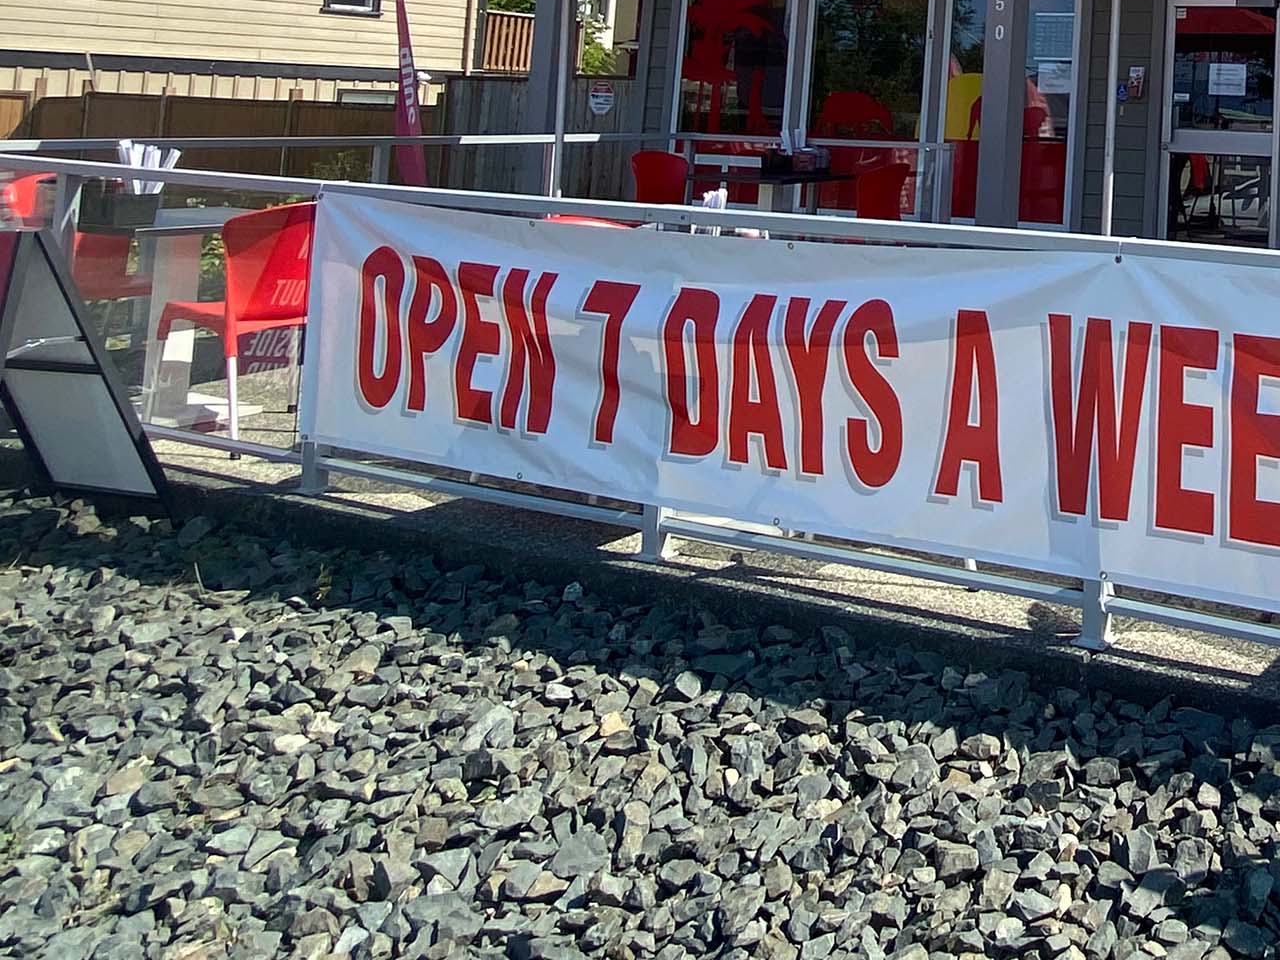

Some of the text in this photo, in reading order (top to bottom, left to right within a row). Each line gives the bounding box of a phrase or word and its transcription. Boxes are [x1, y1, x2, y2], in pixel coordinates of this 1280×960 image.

[358, 245, 558, 435] OPEN
[583, 280, 642, 445] 7
[664, 287, 903, 489] DAYS
[933, 309, 1004, 504] A
